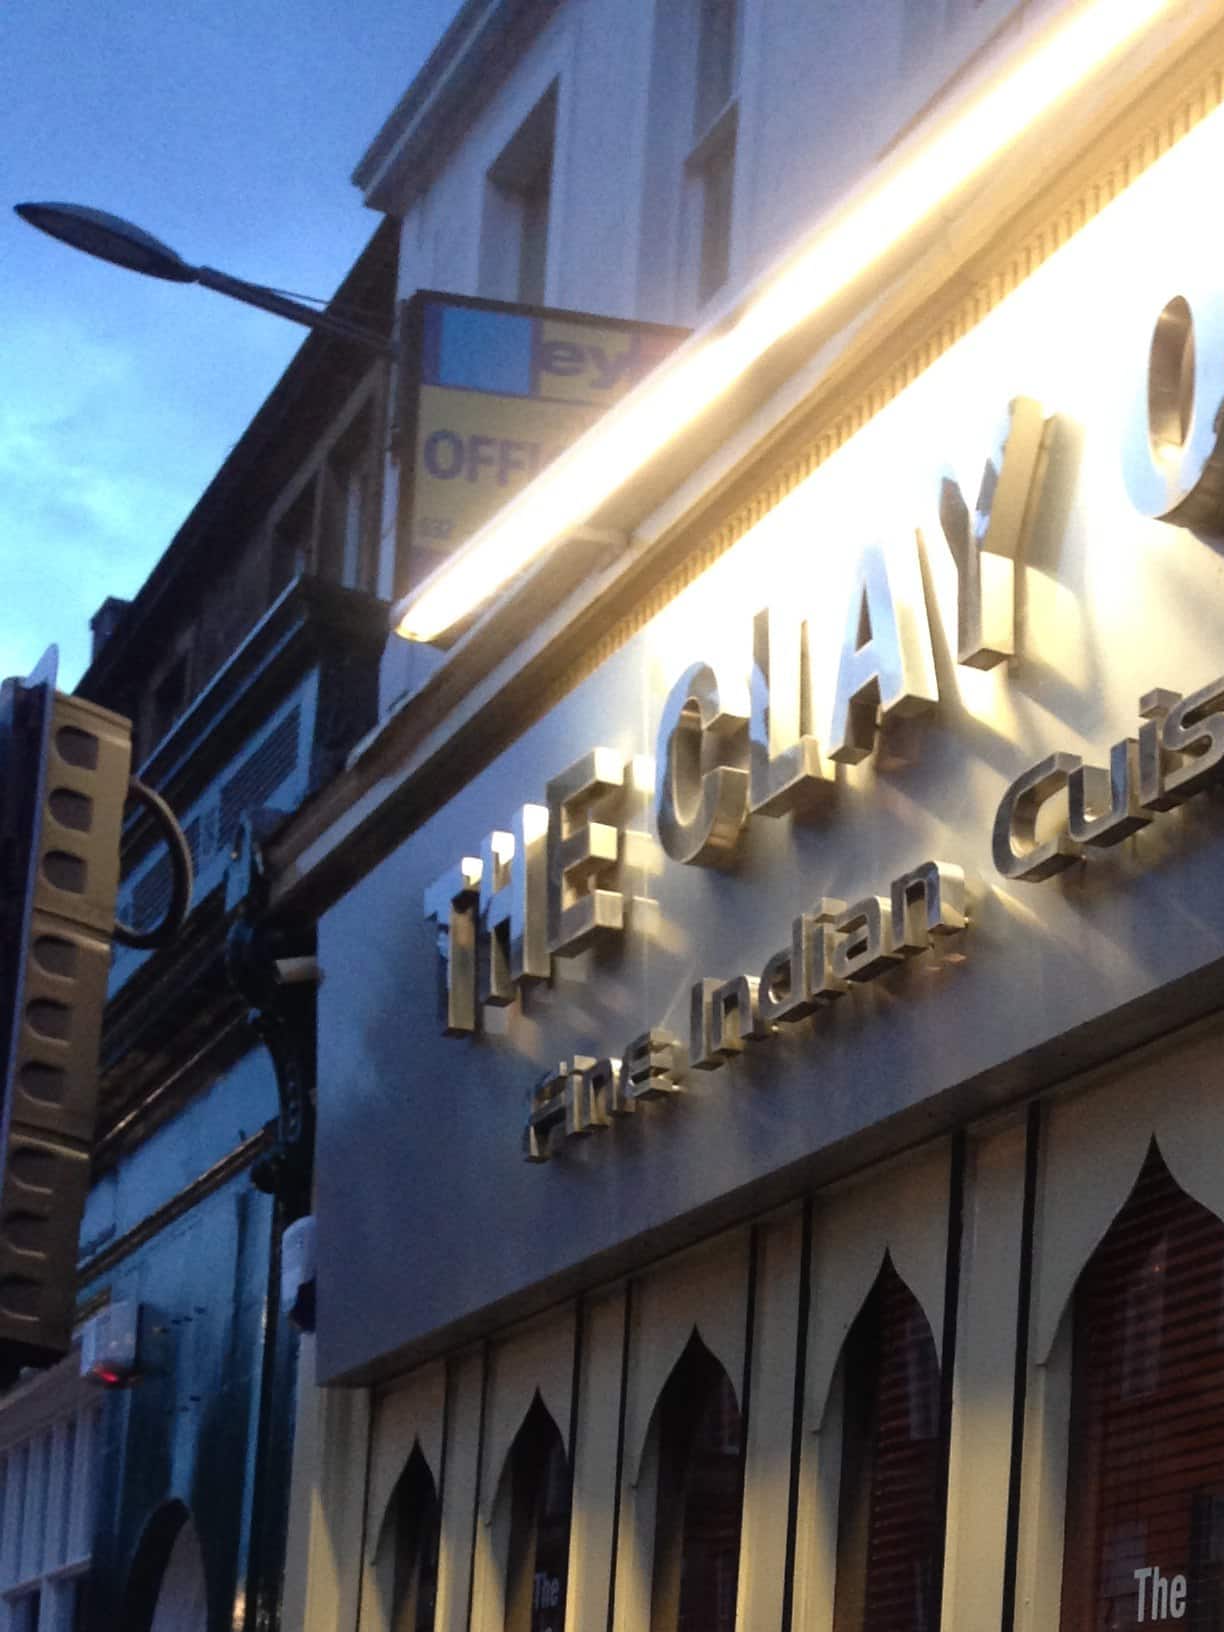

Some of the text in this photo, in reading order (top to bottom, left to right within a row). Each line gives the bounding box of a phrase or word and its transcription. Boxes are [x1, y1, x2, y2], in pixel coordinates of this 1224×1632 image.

[422, 746, 625, 1037] THE
[655, 394, 1048, 866] CLAY
[690, 858, 967, 1071] Indian
[1134, 1566, 1187, 1622] The
